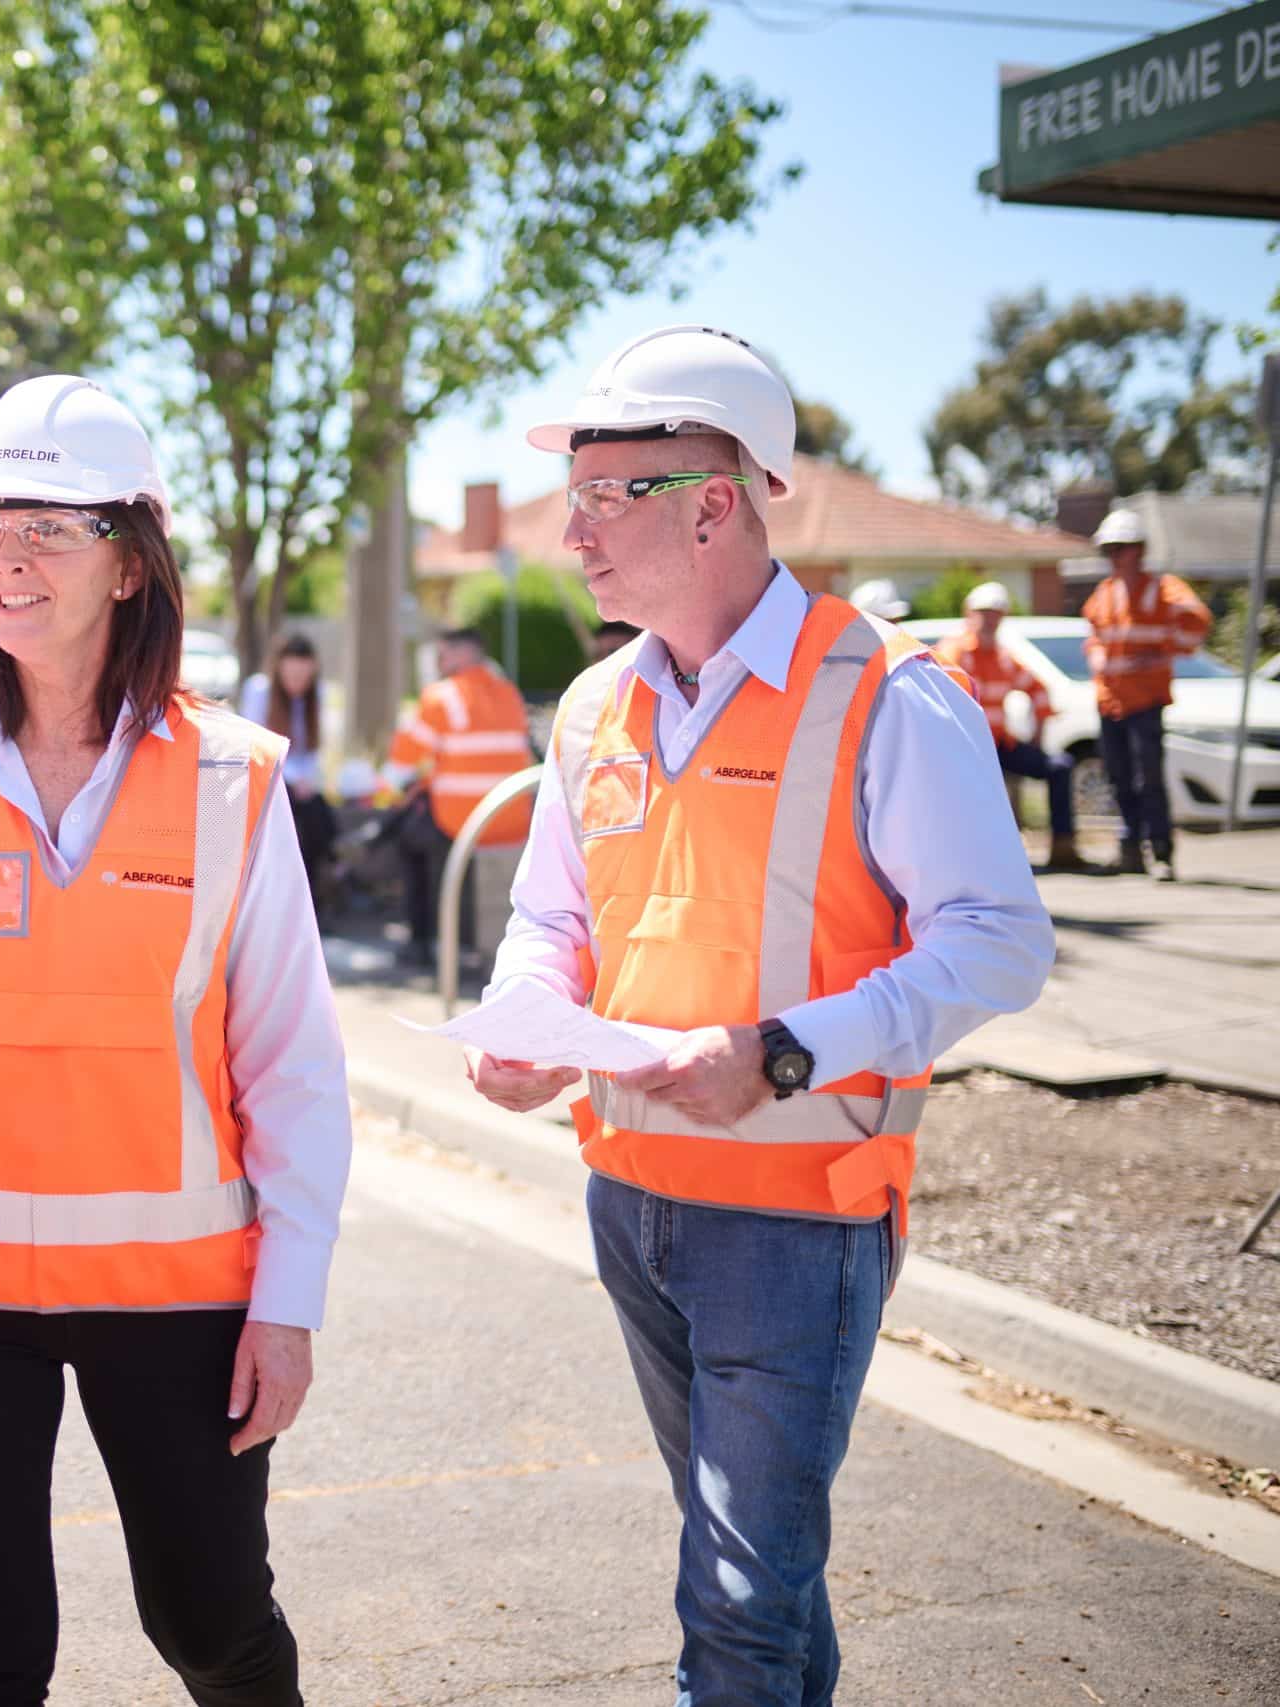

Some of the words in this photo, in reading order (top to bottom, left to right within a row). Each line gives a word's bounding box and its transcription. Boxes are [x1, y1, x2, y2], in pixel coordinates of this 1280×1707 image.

[1018, 77, 1103, 151] FREE
[1111, 40, 1224, 124] HOME
[715, 767, 777, 781] ABERGELDIE
[122, 872, 194, 888] ABERGELDIE
